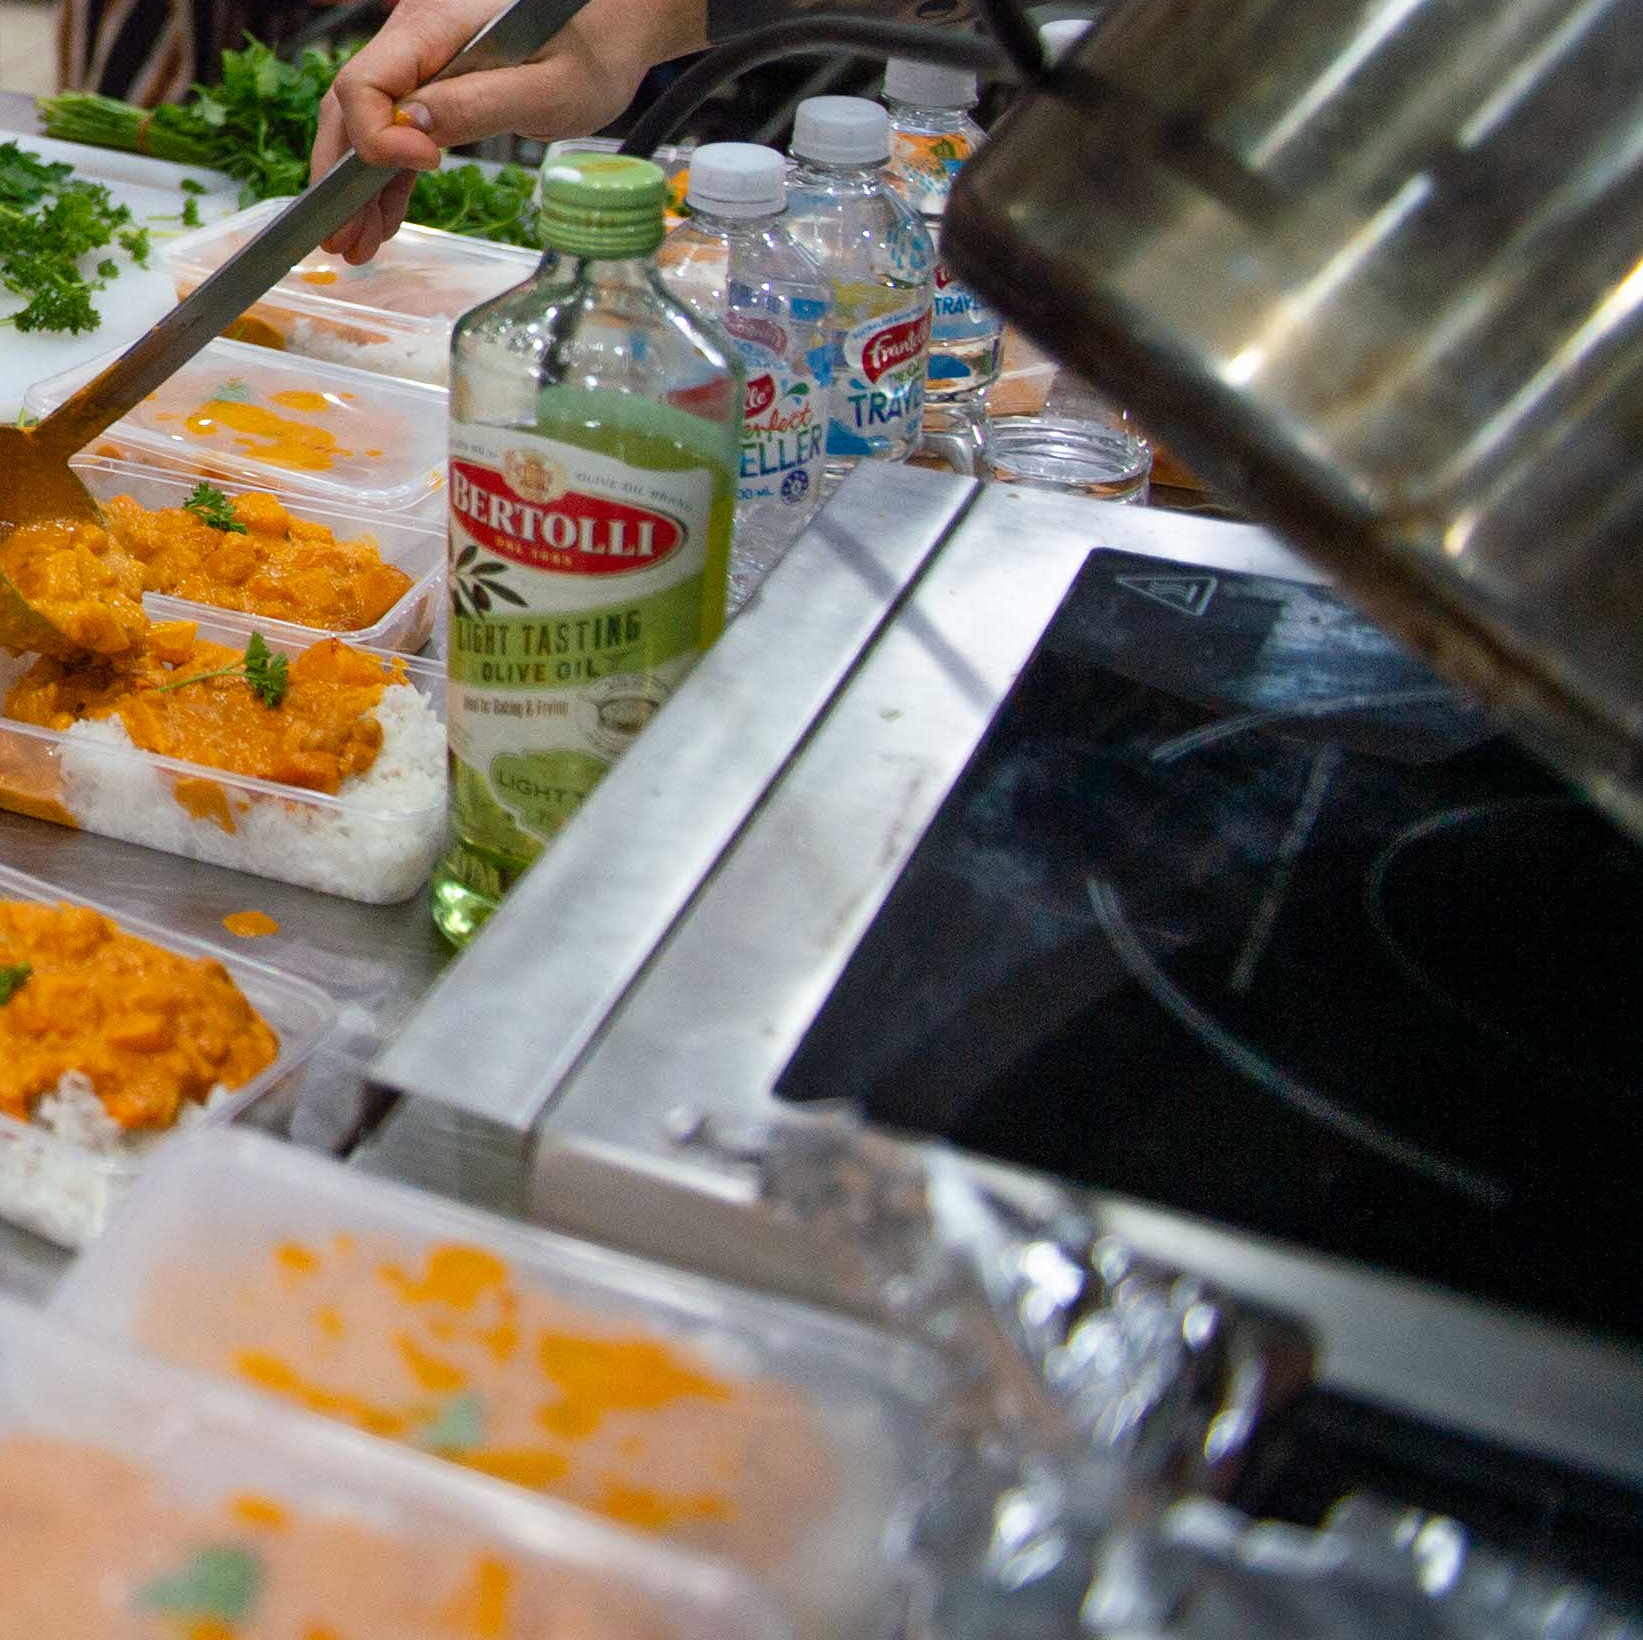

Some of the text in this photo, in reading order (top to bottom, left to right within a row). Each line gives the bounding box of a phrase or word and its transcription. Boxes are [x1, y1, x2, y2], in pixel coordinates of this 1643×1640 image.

[739, 423, 823, 479] ELLER
[452, 466, 658, 558] BERTOLLI
[456, 610, 642, 657] LIGHT TASTING
[480, 658, 601, 684] OLIVE OIL
